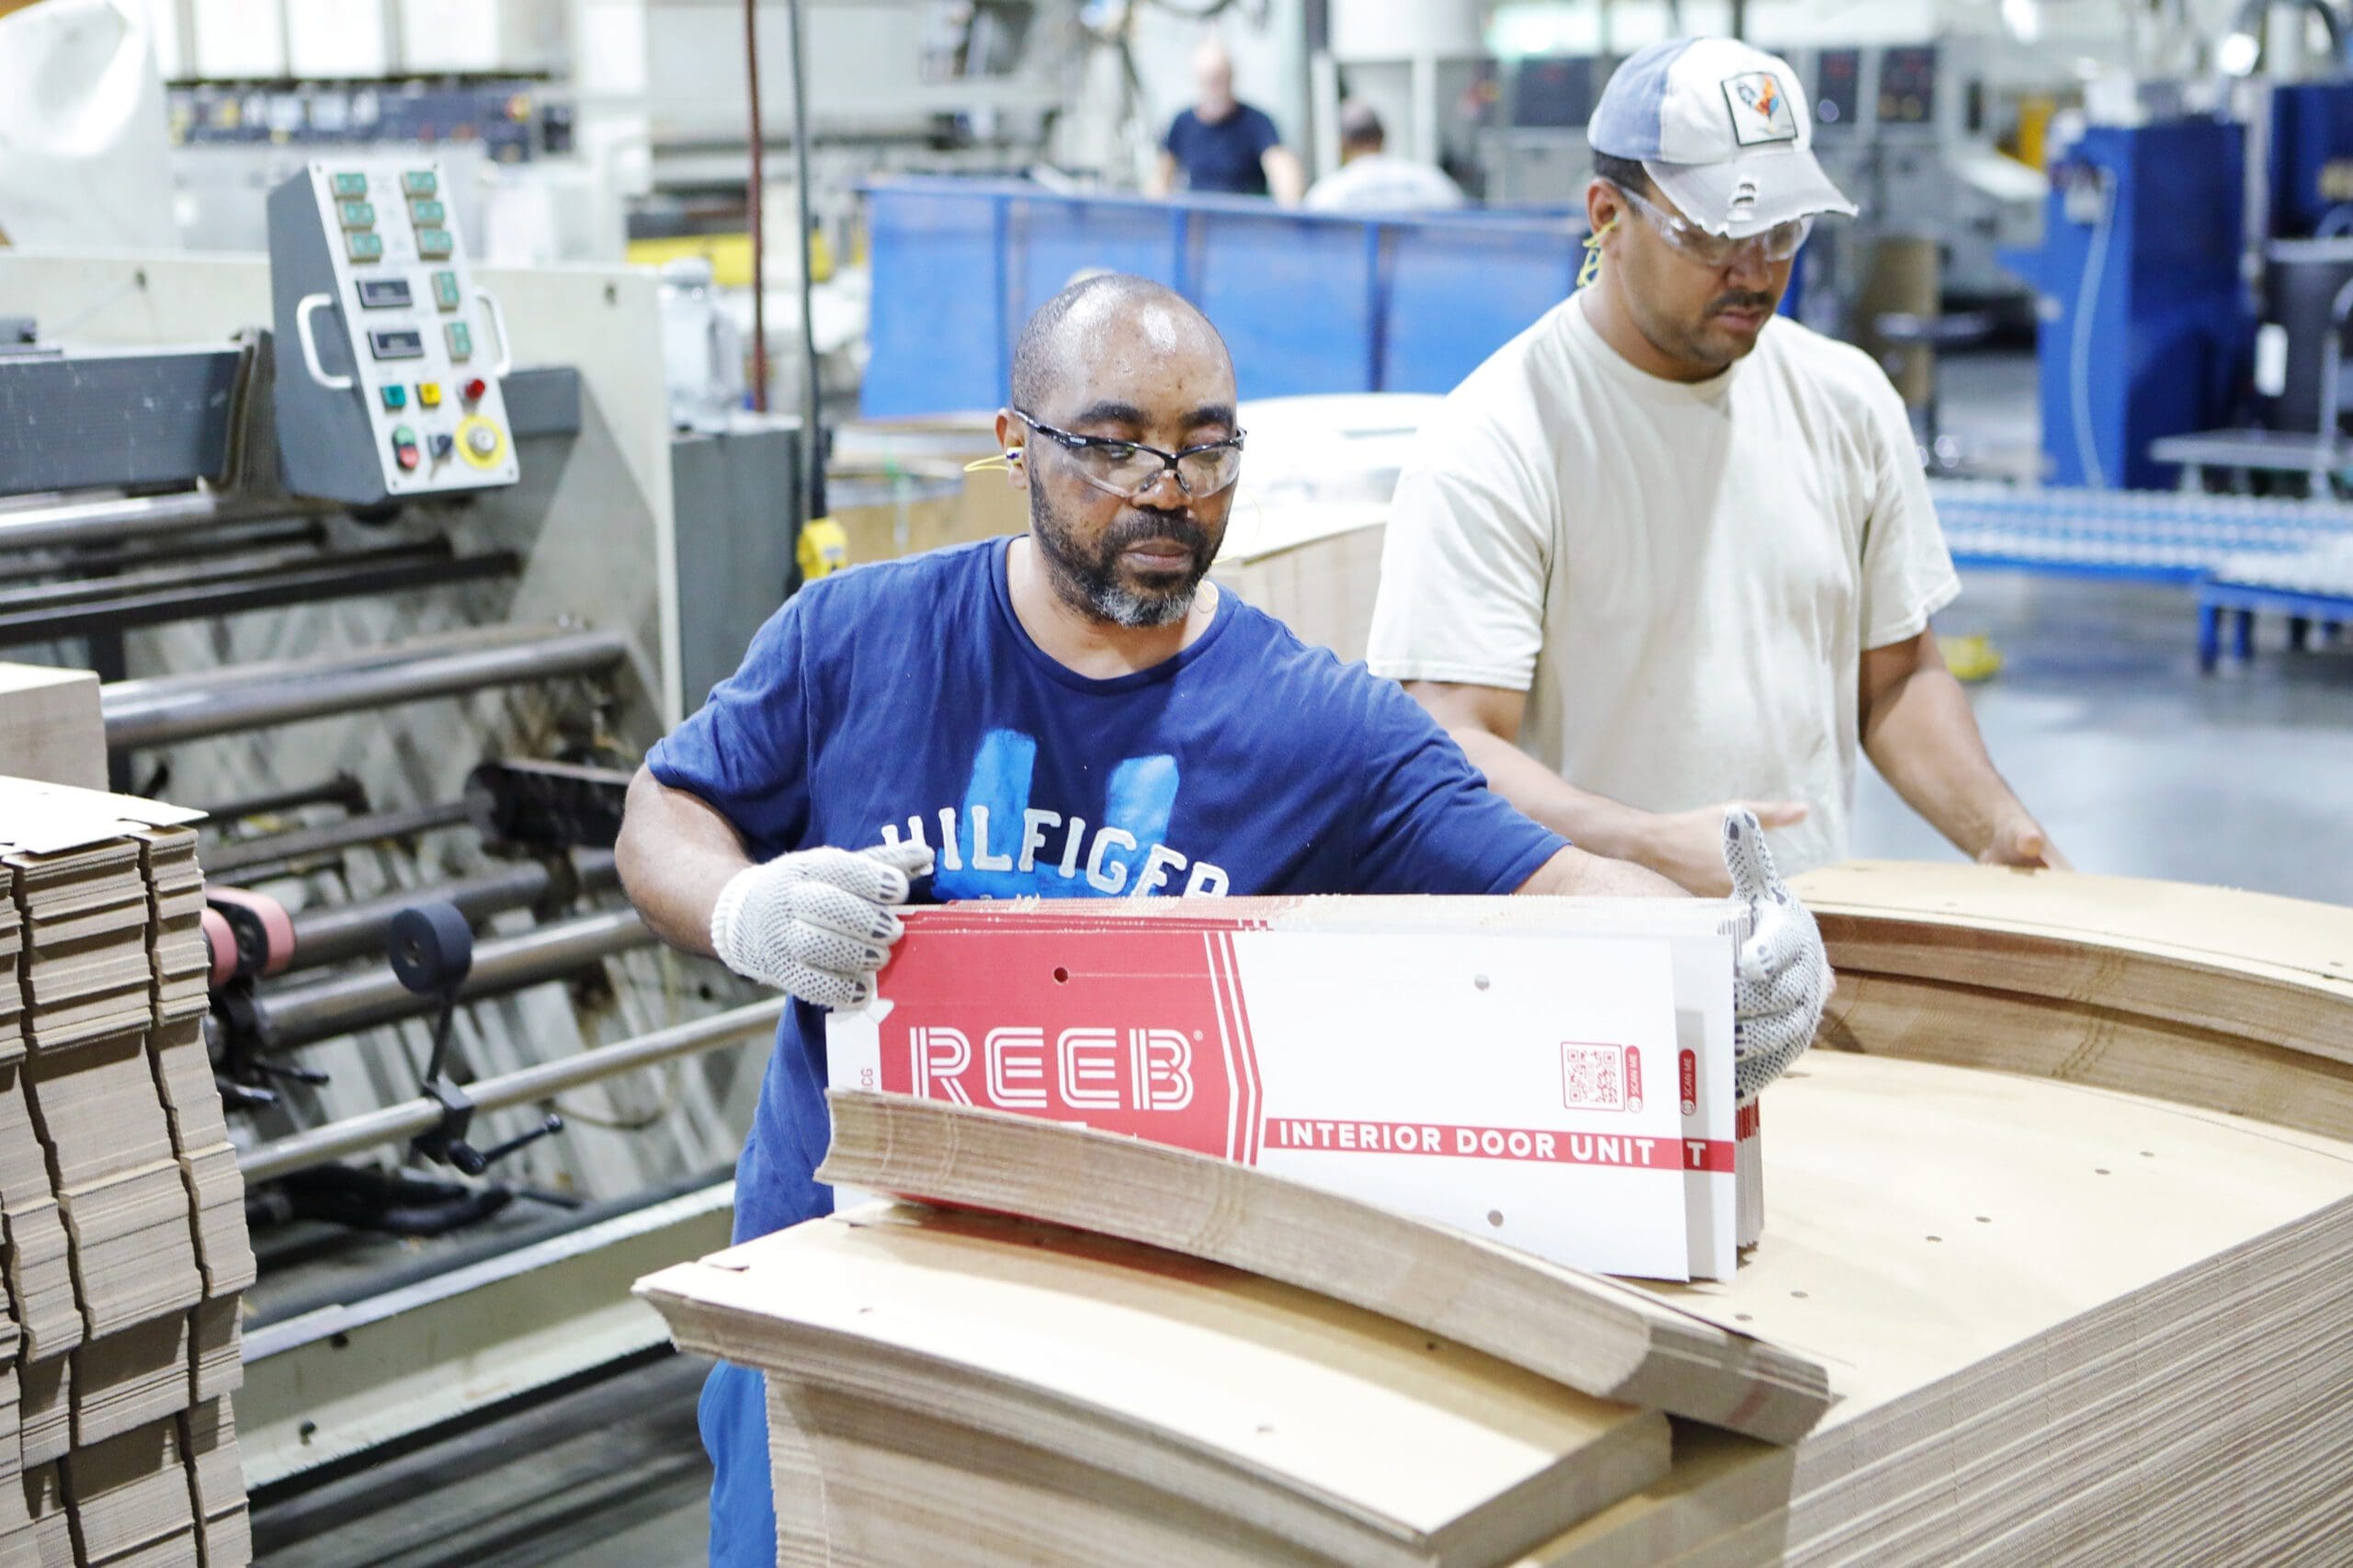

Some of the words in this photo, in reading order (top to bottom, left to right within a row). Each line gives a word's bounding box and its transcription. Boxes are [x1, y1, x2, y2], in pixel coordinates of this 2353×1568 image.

[1279, 1120, 1441, 1152] INTERIOR
[1455, 1128, 1555, 1159] DOOR
[1570, 1134, 1654, 1165] UNIT
